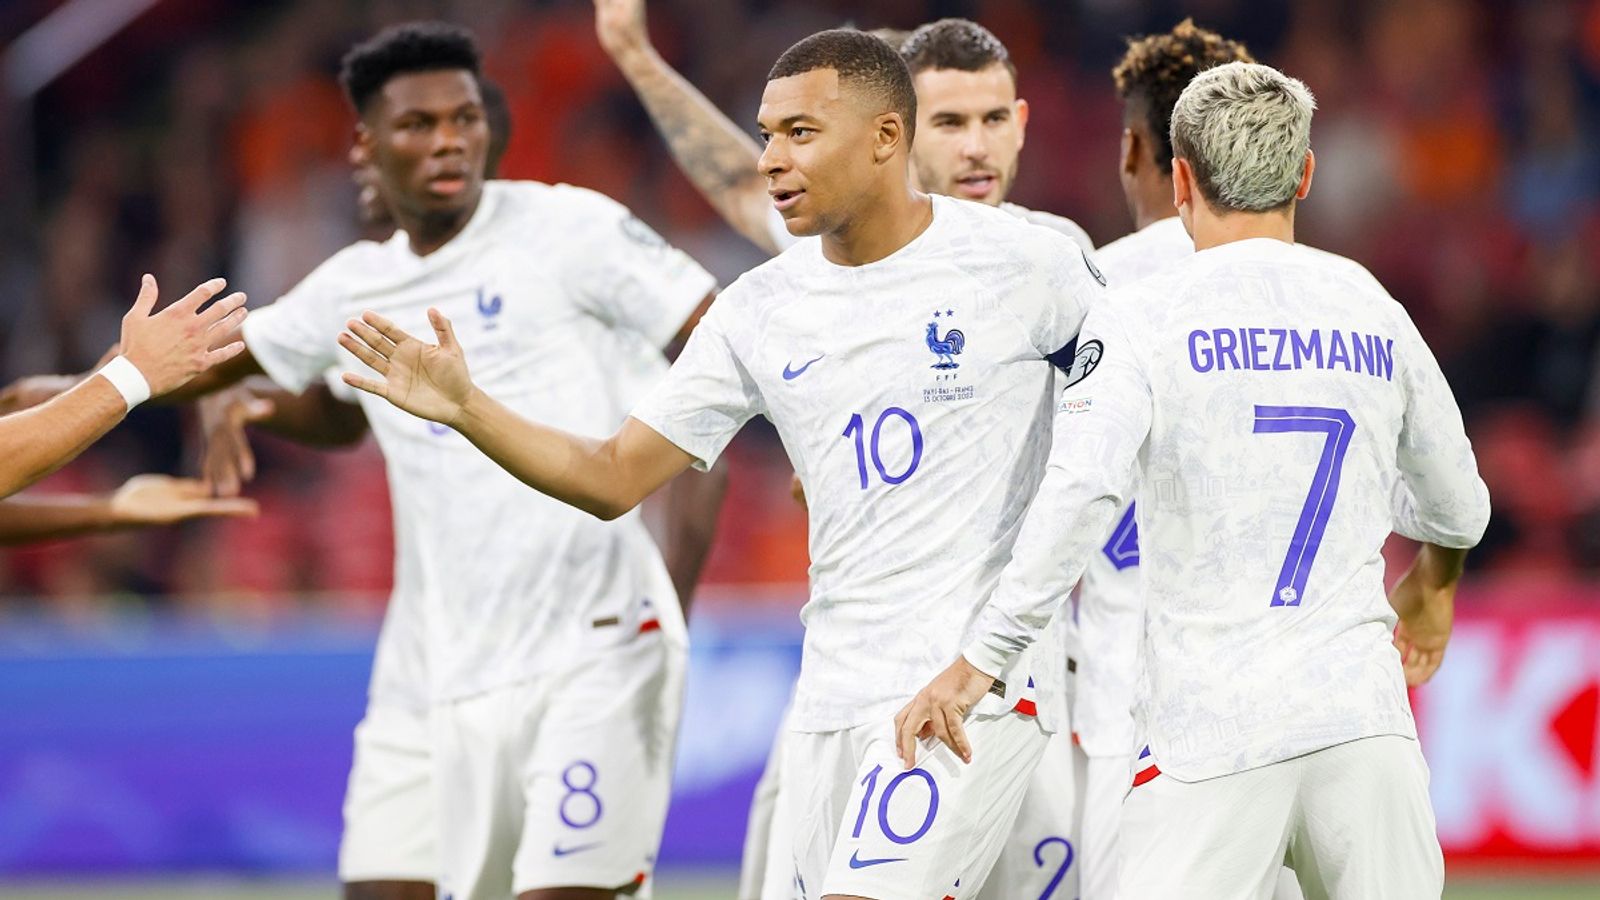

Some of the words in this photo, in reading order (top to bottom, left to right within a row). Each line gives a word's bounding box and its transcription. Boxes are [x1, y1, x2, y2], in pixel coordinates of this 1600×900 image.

[1188, 327, 1394, 382] GRIEZMANN
[1059, 399, 1093, 410] ATION
[842, 406, 924, 490] 10
[1252, 404, 1357, 608] 7
[1428, 617, 1600, 846] K
[559, 761, 603, 830] 8
[852, 764, 940, 845] 10
